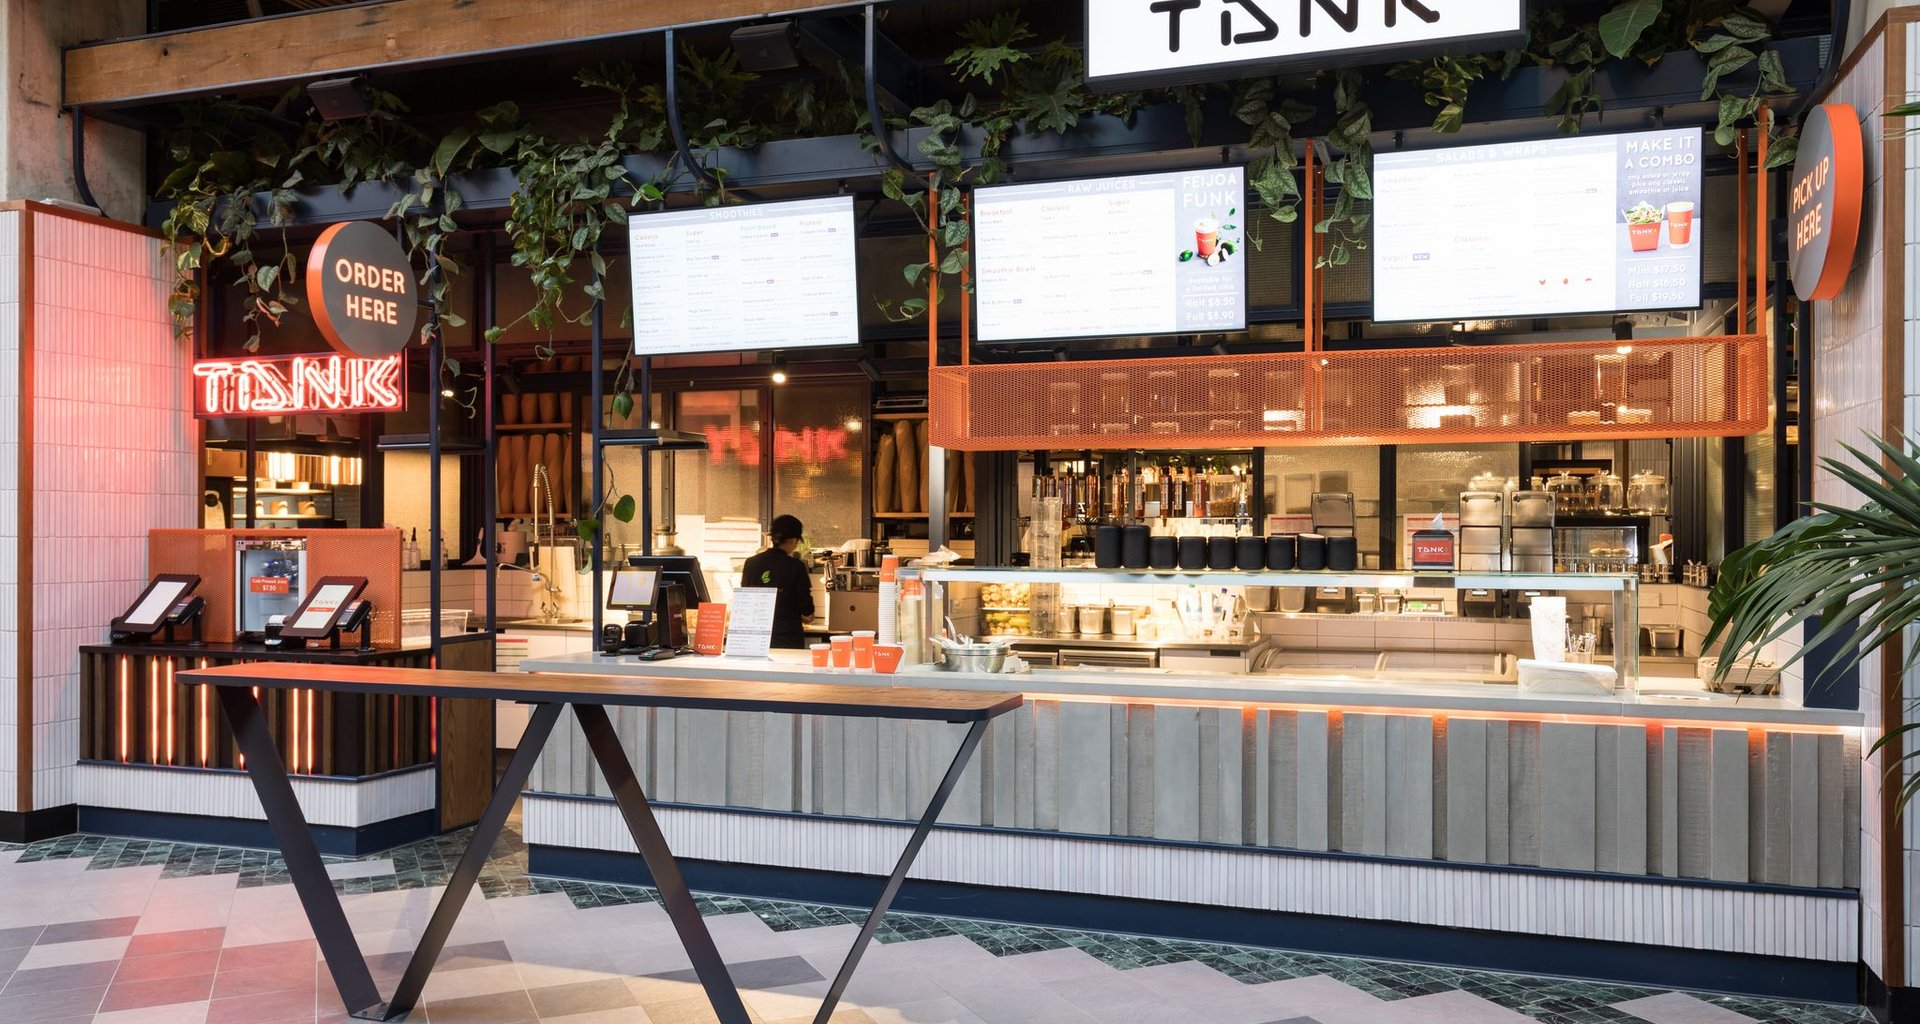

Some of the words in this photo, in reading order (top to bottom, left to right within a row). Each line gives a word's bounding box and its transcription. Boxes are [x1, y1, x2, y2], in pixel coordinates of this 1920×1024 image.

[1626, 138, 1672, 153] MAKE
[1680, 136, 1694, 149] IT
[1436, 149, 1485, 163] SALADS
[1502, 144, 1547, 158] WRAPS
[1625, 158, 1634, 169] A
[1638, 153, 1695, 168] COMBO
[1068, 183, 1092, 193] RAW
[1096, 179, 1136, 191] JUICES
[1182, 173, 1237, 189] FEIJOA
[1792, 172, 1813, 214] PICK
[1815, 156, 1829, 192] UP
[1182, 190, 1237, 208] FUNK
[708, 208, 764, 221] SMOOTHIES
[1796, 202, 1822, 251] HERE
[335, 258, 405, 294] ORDER
[1628, 279, 1649, 289] Half
[1185, 298, 1205, 308] Half
[1207, 296, 1235, 307] $6.50
[1630, 292, 1649, 303] Full
[1651, 291, 1685, 302] $19.50
[346, 294, 398, 325] HERE
[1186, 312, 1204, 321] Full
[1207, 310, 1234, 320] $6.90
[193, 355, 400, 412] TANK
